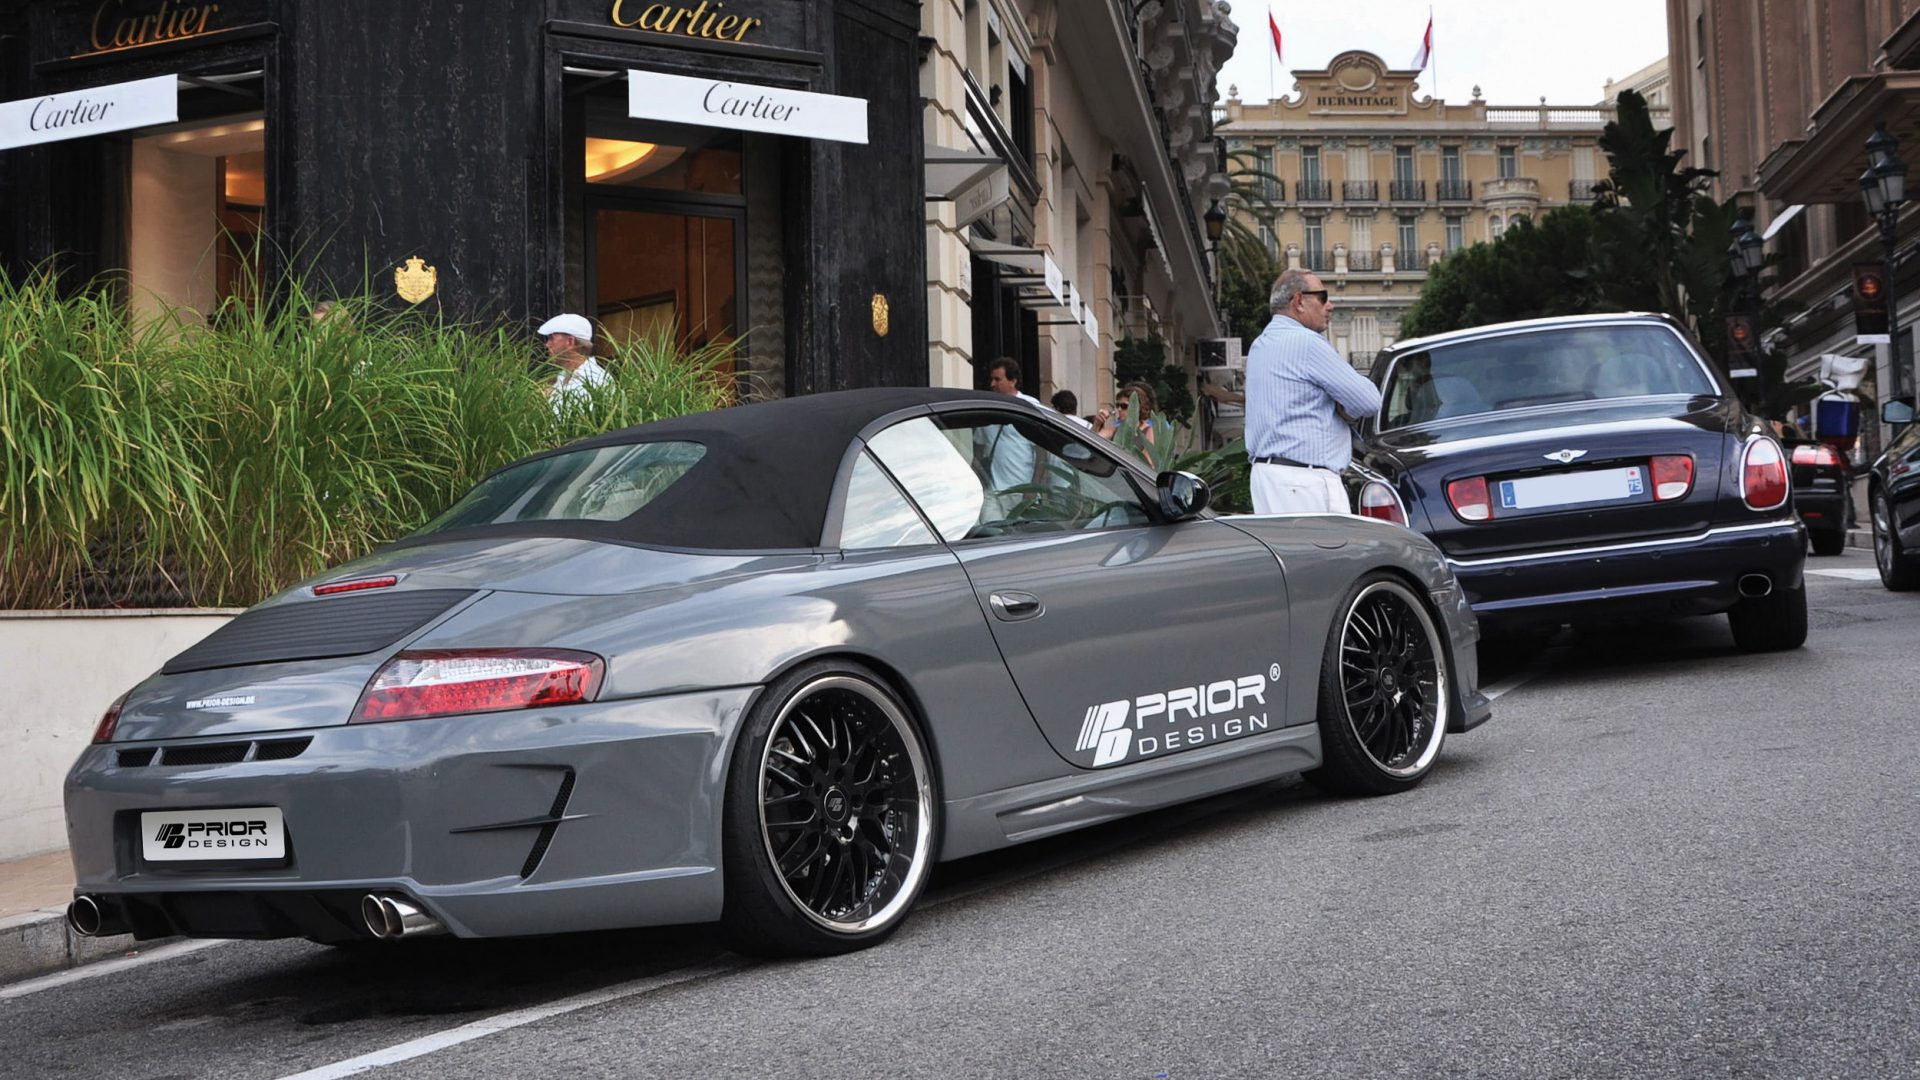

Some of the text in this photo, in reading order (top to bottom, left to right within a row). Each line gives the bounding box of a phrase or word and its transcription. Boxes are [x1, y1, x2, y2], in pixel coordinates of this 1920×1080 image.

[91, 0, 219, 50] Cartier
[611, 0, 761, 41] Cartier
[30, 97, 115, 132] Cartier
[703, 81, 800, 122] Cartier
[1316, 96, 1398, 107] HERMITAGE
[1136, 674, 1266, 729] PRIOR
[1138, 713, 1268, 755] DESIGN
[188, 820, 267, 837] PRIOR
[188, 838, 268, 848] DESIGN
